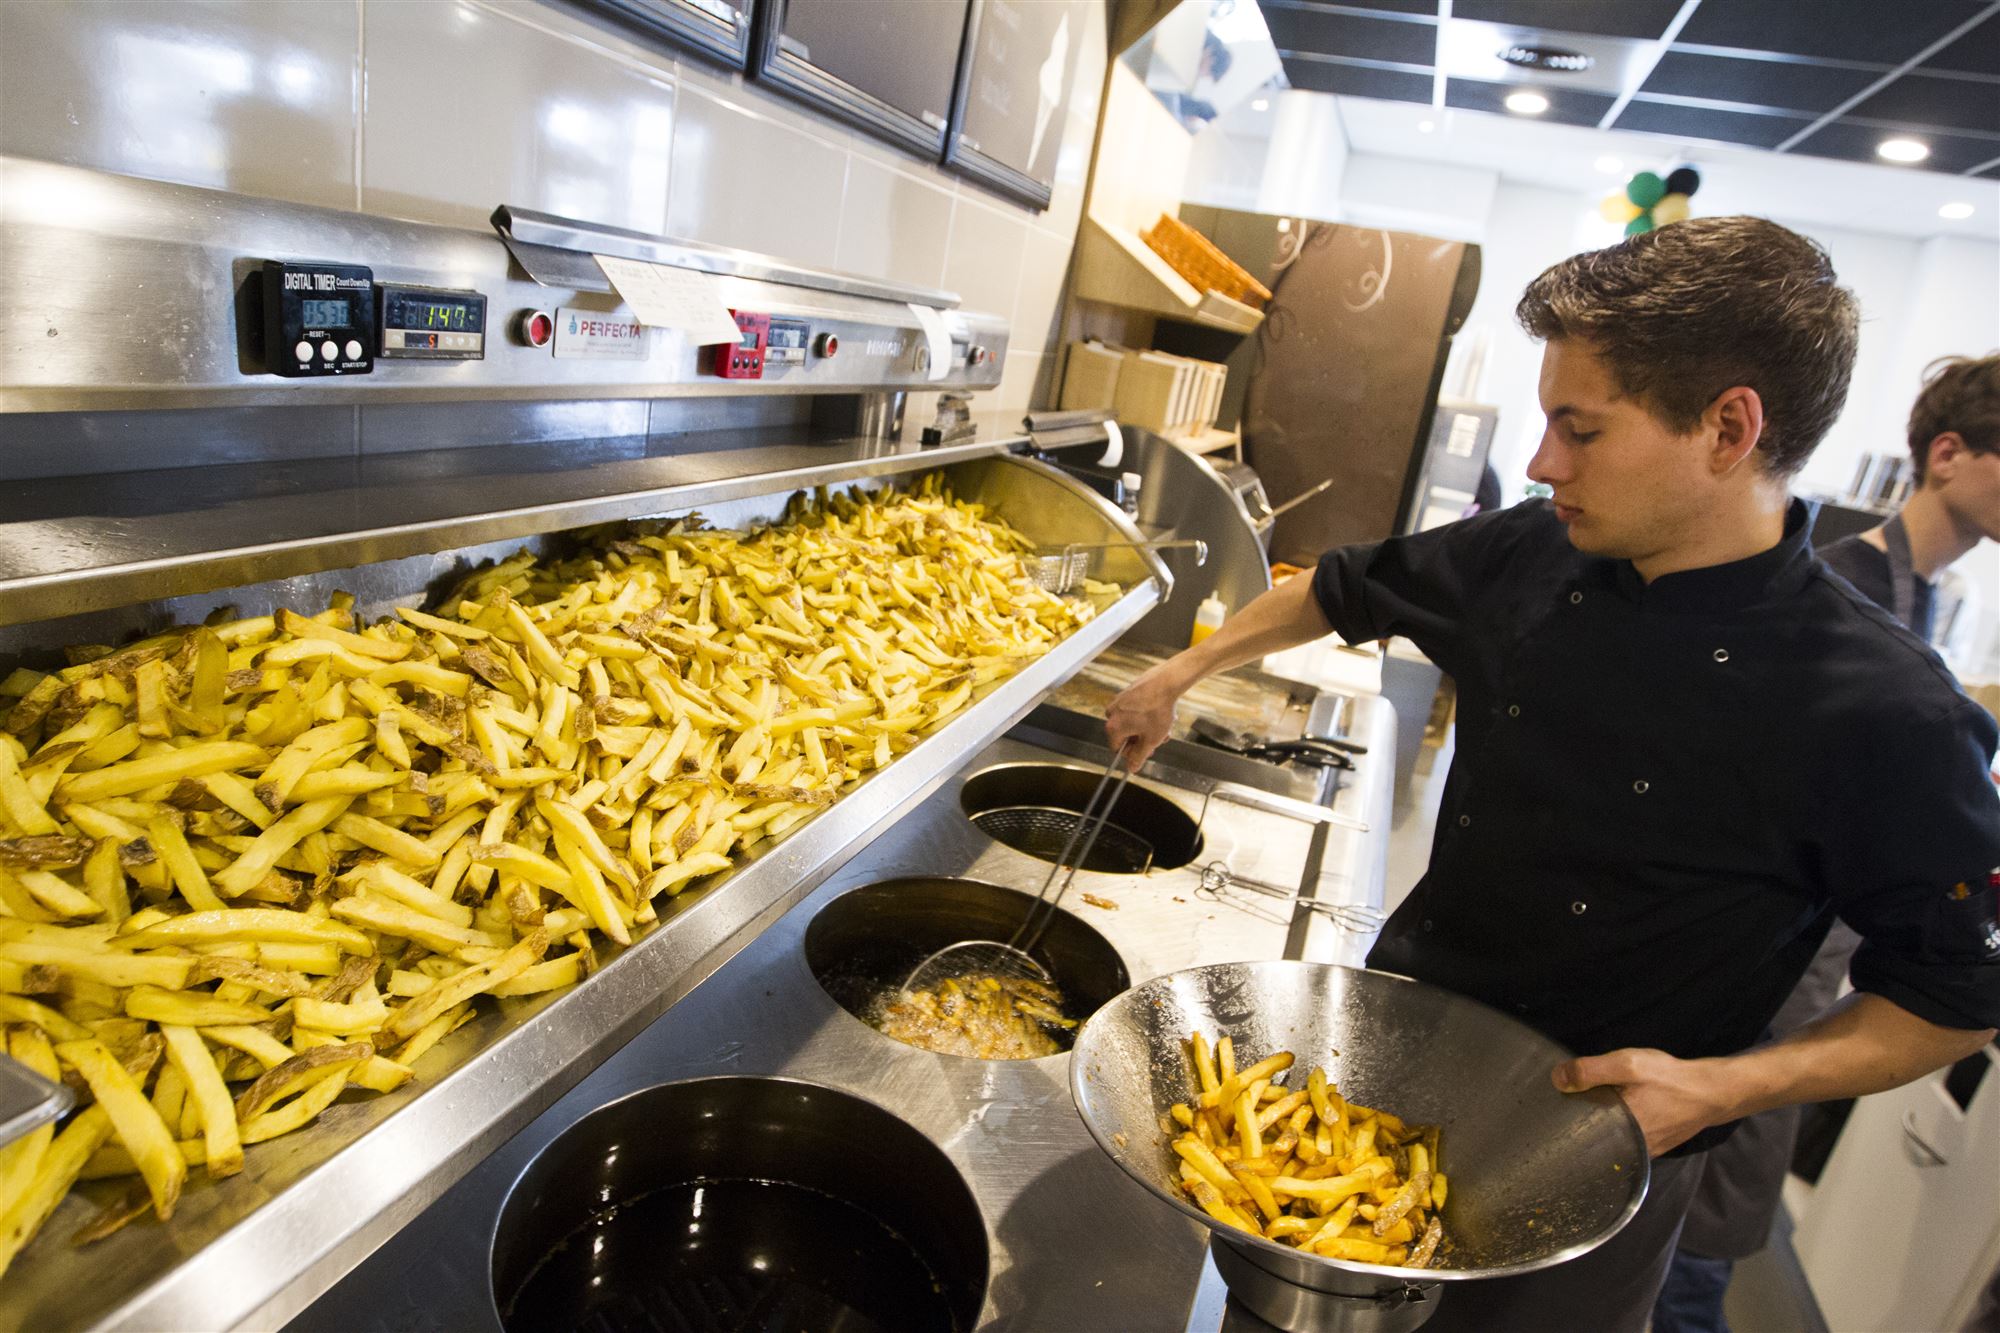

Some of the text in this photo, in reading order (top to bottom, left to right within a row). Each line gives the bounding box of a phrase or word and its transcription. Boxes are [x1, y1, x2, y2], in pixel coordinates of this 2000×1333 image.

[284, 273, 336, 291] DIGITAL TIMER
[336, 277, 350, 287] Count
[428, 305, 467, 328] 147
[580, 320, 641, 339] PERFECTA
